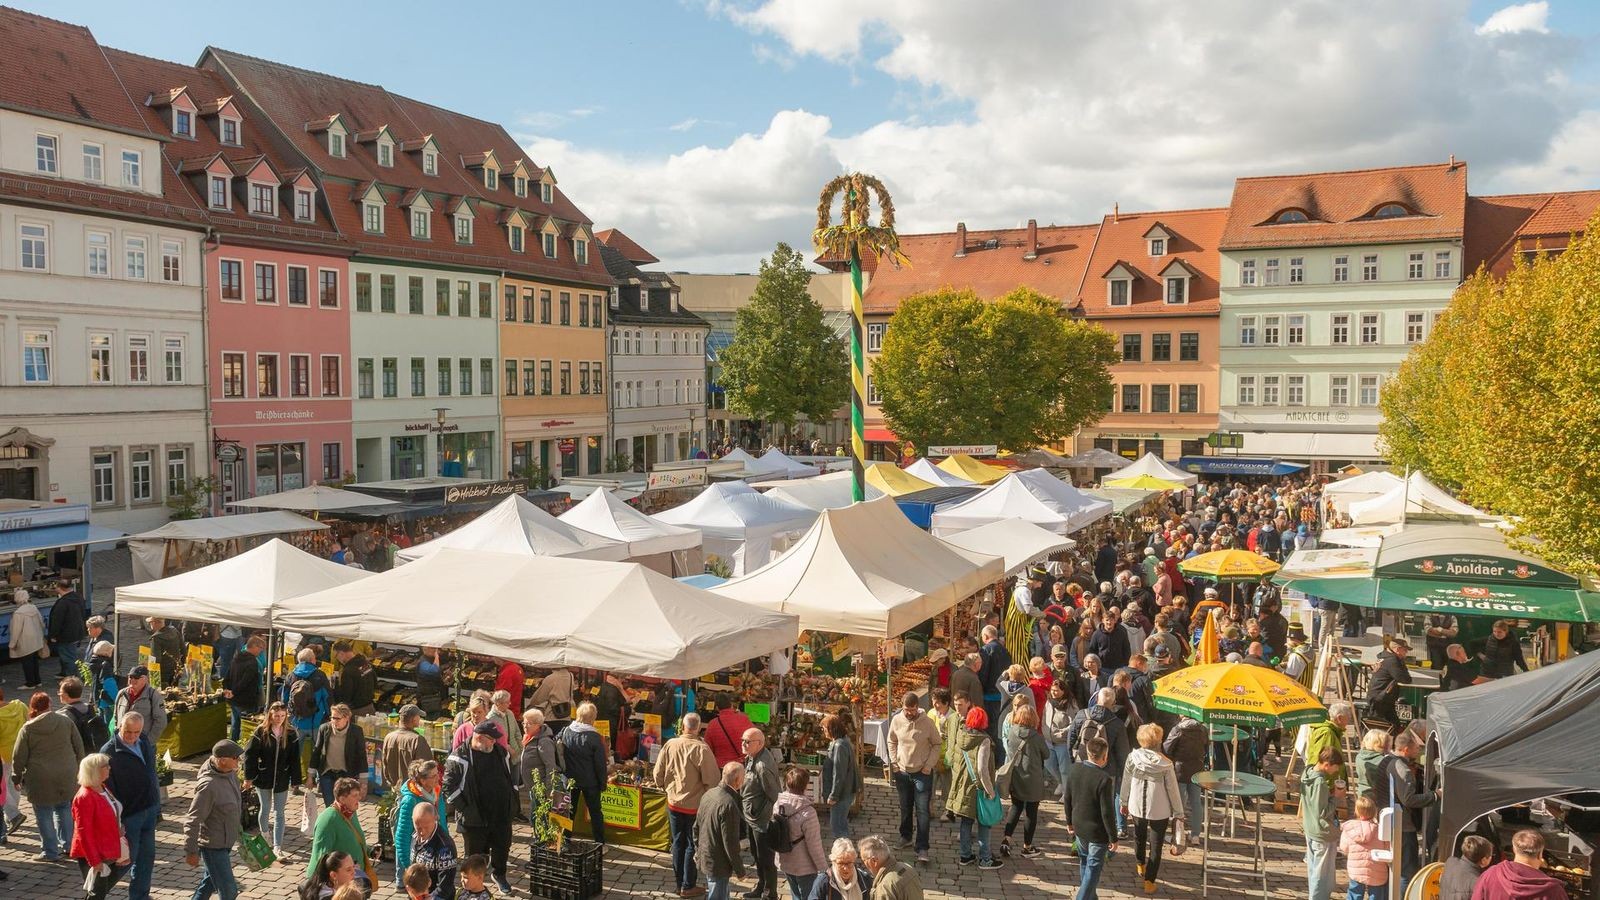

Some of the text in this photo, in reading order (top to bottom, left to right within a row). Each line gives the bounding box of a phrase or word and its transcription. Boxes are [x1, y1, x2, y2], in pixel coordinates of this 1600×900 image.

[1446, 562, 1504, 576] Apoldaer
[1413, 597, 1541, 613] Apoldaer
[1168, 686, 1204, 700] Apoldaer
[1214, 696, 1264, 708] Apoldaer
[1273, 697, 1308, 708] Apoldaer
[1226, 713, 1268, 723] Heimatbier.
[601, 796, 633, 807] ARYLLIS
